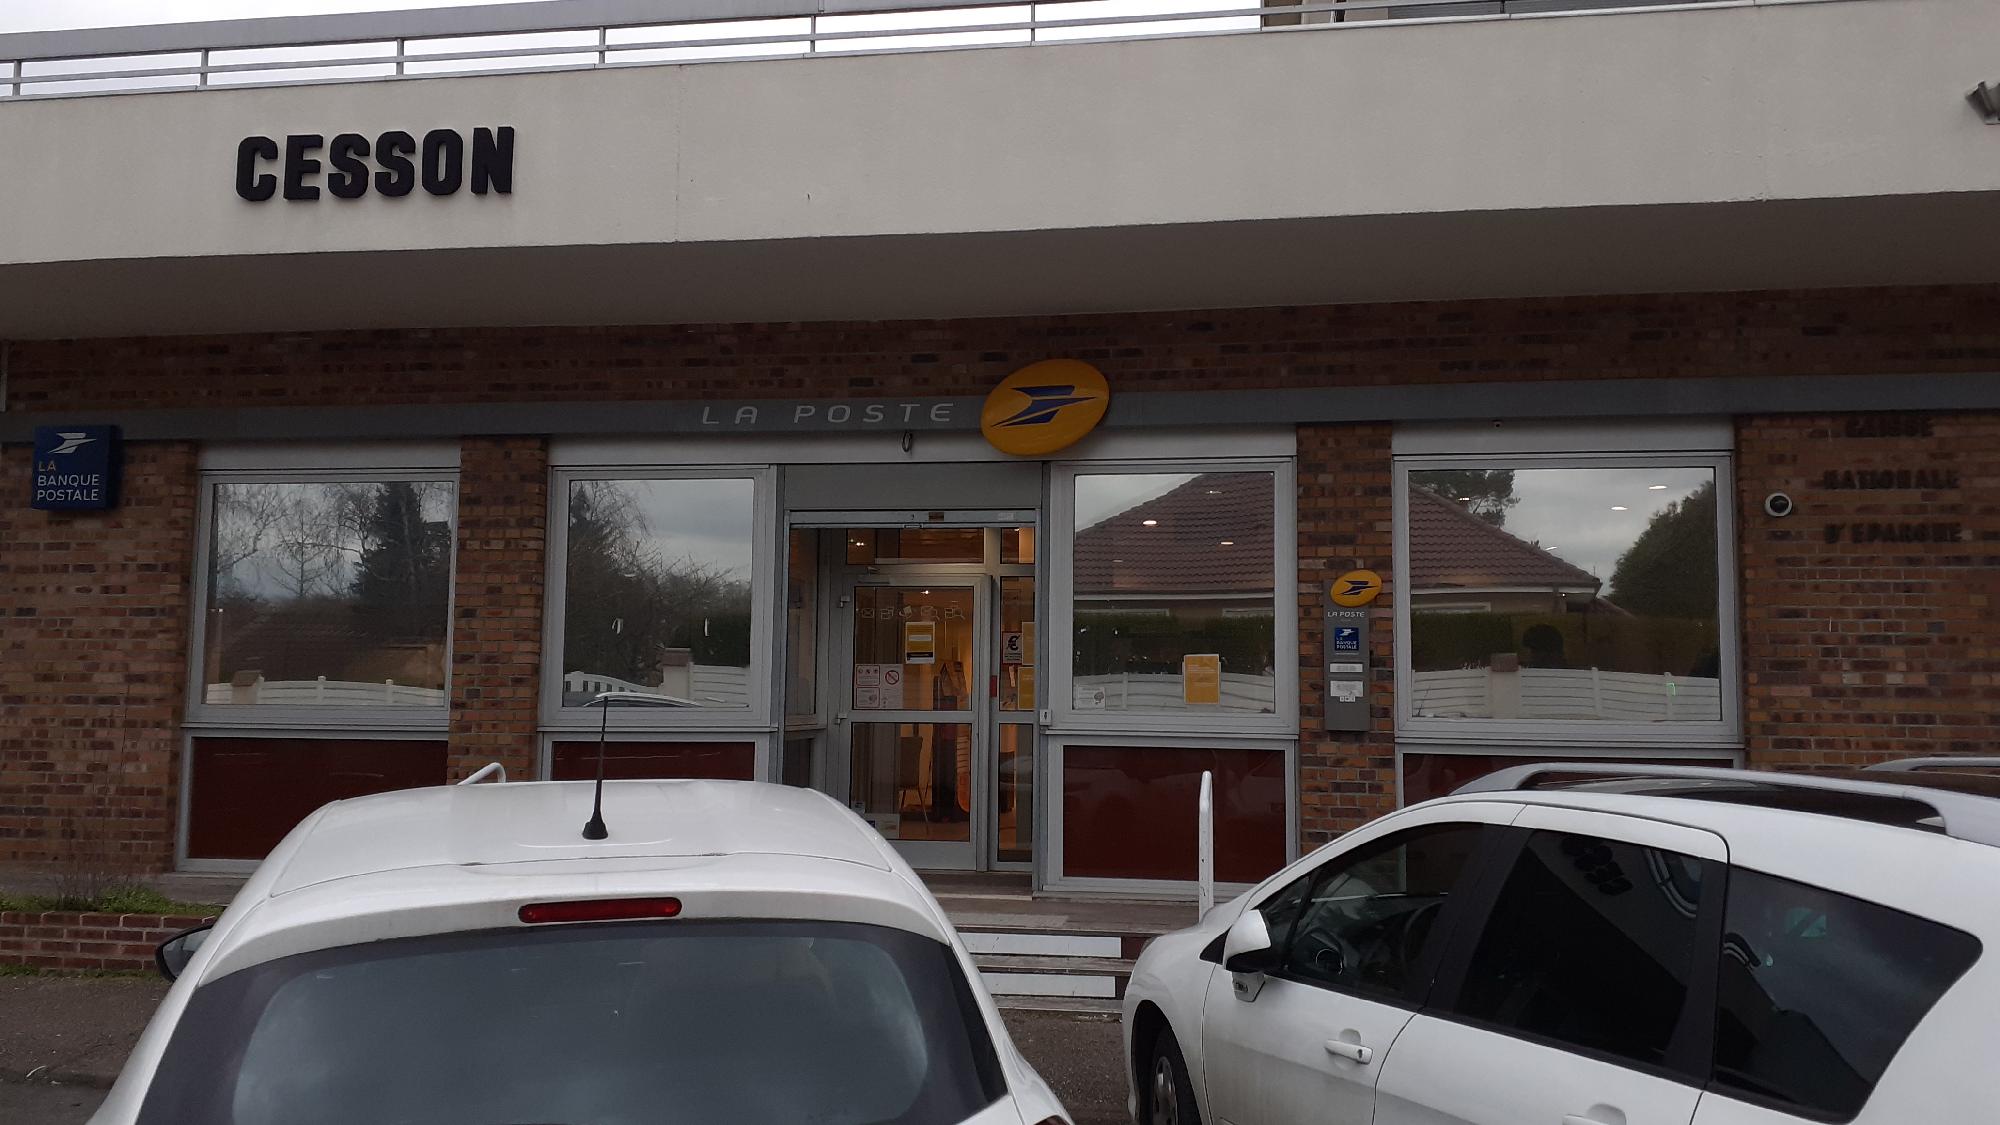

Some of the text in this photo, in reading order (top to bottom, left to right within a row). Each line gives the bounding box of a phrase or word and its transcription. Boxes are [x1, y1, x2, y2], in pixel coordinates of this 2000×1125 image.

[235, 126, 515, 201] CESSON
[702, 402, 955, 425] LA POSTE
[38, 460, 57, 472] LA
[37, 474, 101, 487] BANQUE
[36, 488, 100, 501] POSTALE
